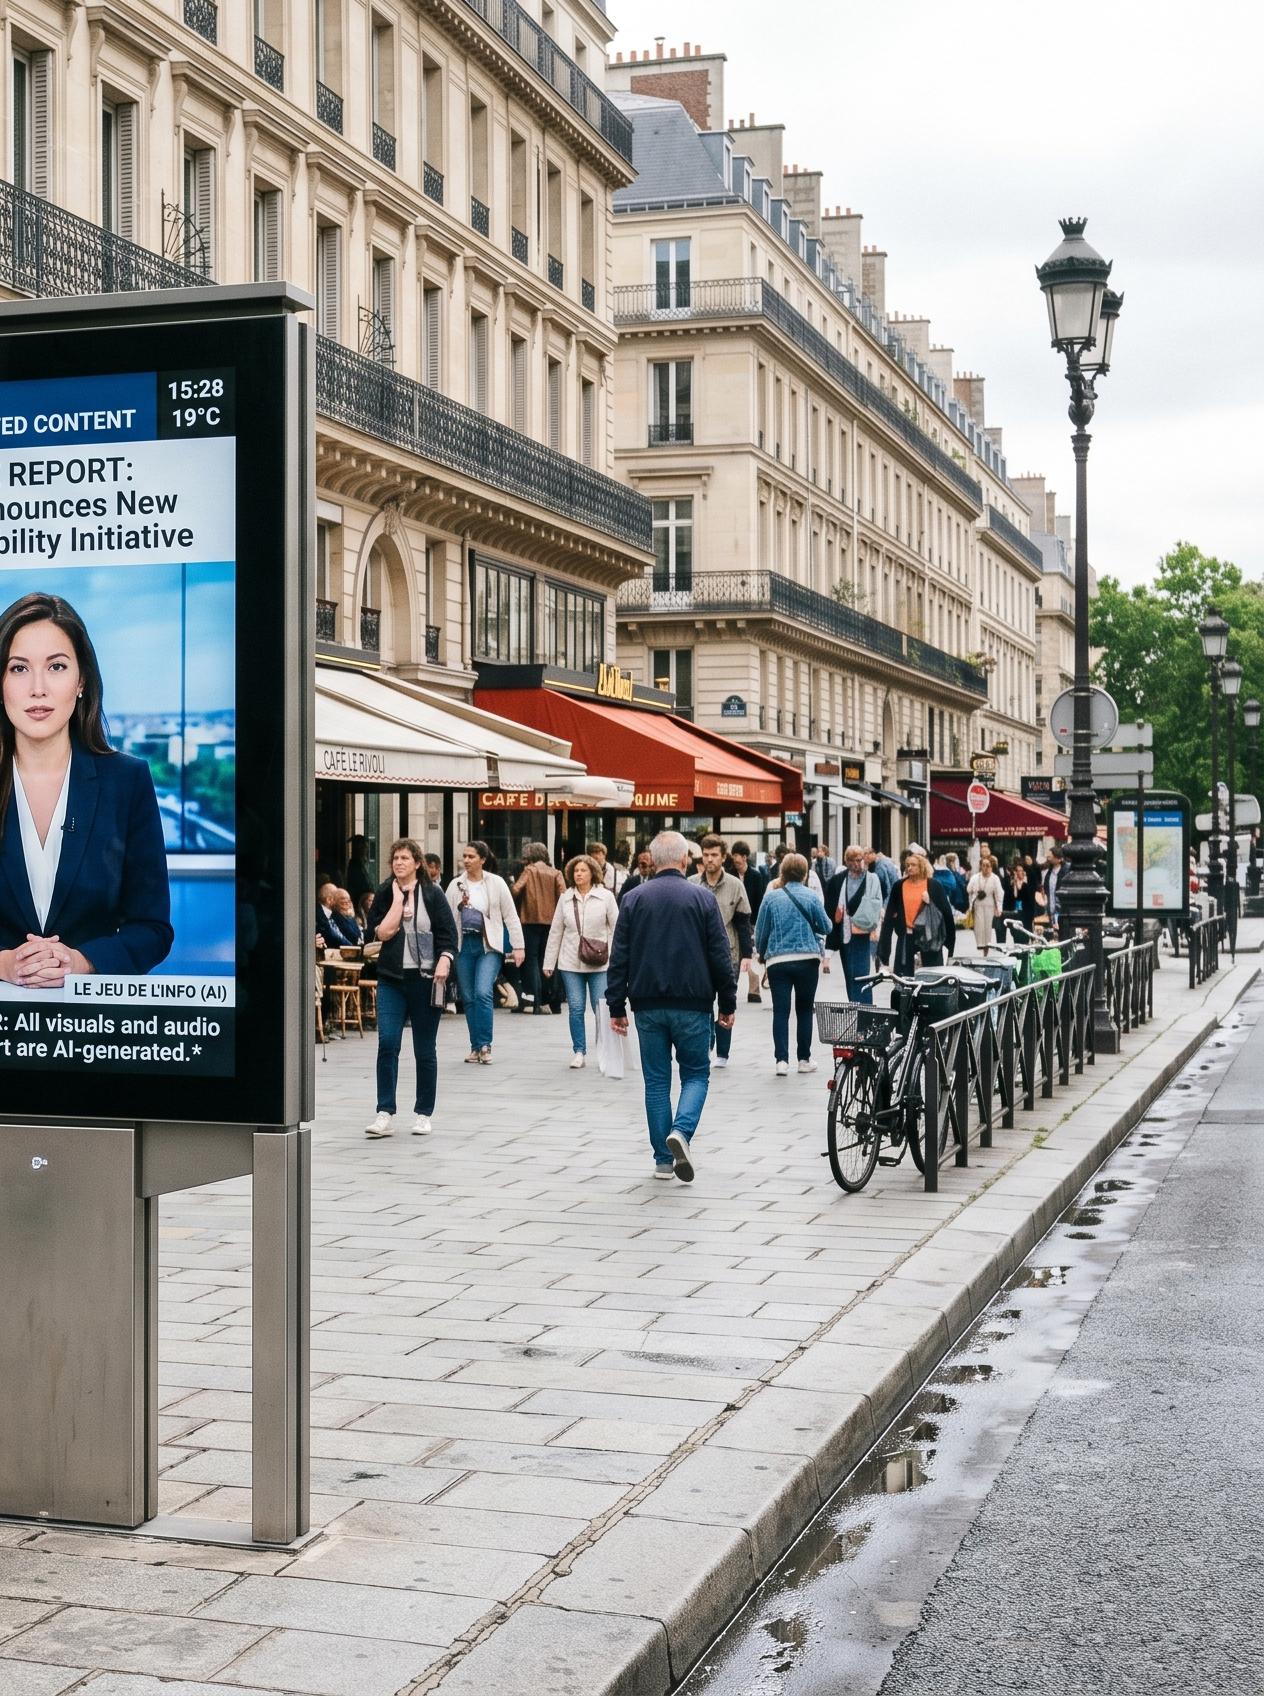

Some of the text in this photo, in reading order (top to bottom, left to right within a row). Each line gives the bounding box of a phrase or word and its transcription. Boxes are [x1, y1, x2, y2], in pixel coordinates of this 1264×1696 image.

[168, 378, 225, 401] 15:28
[33, 408, 137, 434] CONTENT
[172, 406, 221, 428] 19°C
[8, 456, 134, 488] REPORT:
[116, 490, 179, 517] New
[71, 523, 195, 552] Initiative
[323, 746, 386, 774] CAFÉ LE RIVOLI
[74, 981, 228, 1003] LE JEU DE L'INFO (AI)
[14, 1012, 41, 1032] All
[46, 1013, 115, 1034] visuals
[121, 1016, 159, 1036] and
[164, 1016, 221, 1037] audio
[16, 1043, 48, 1057] are
